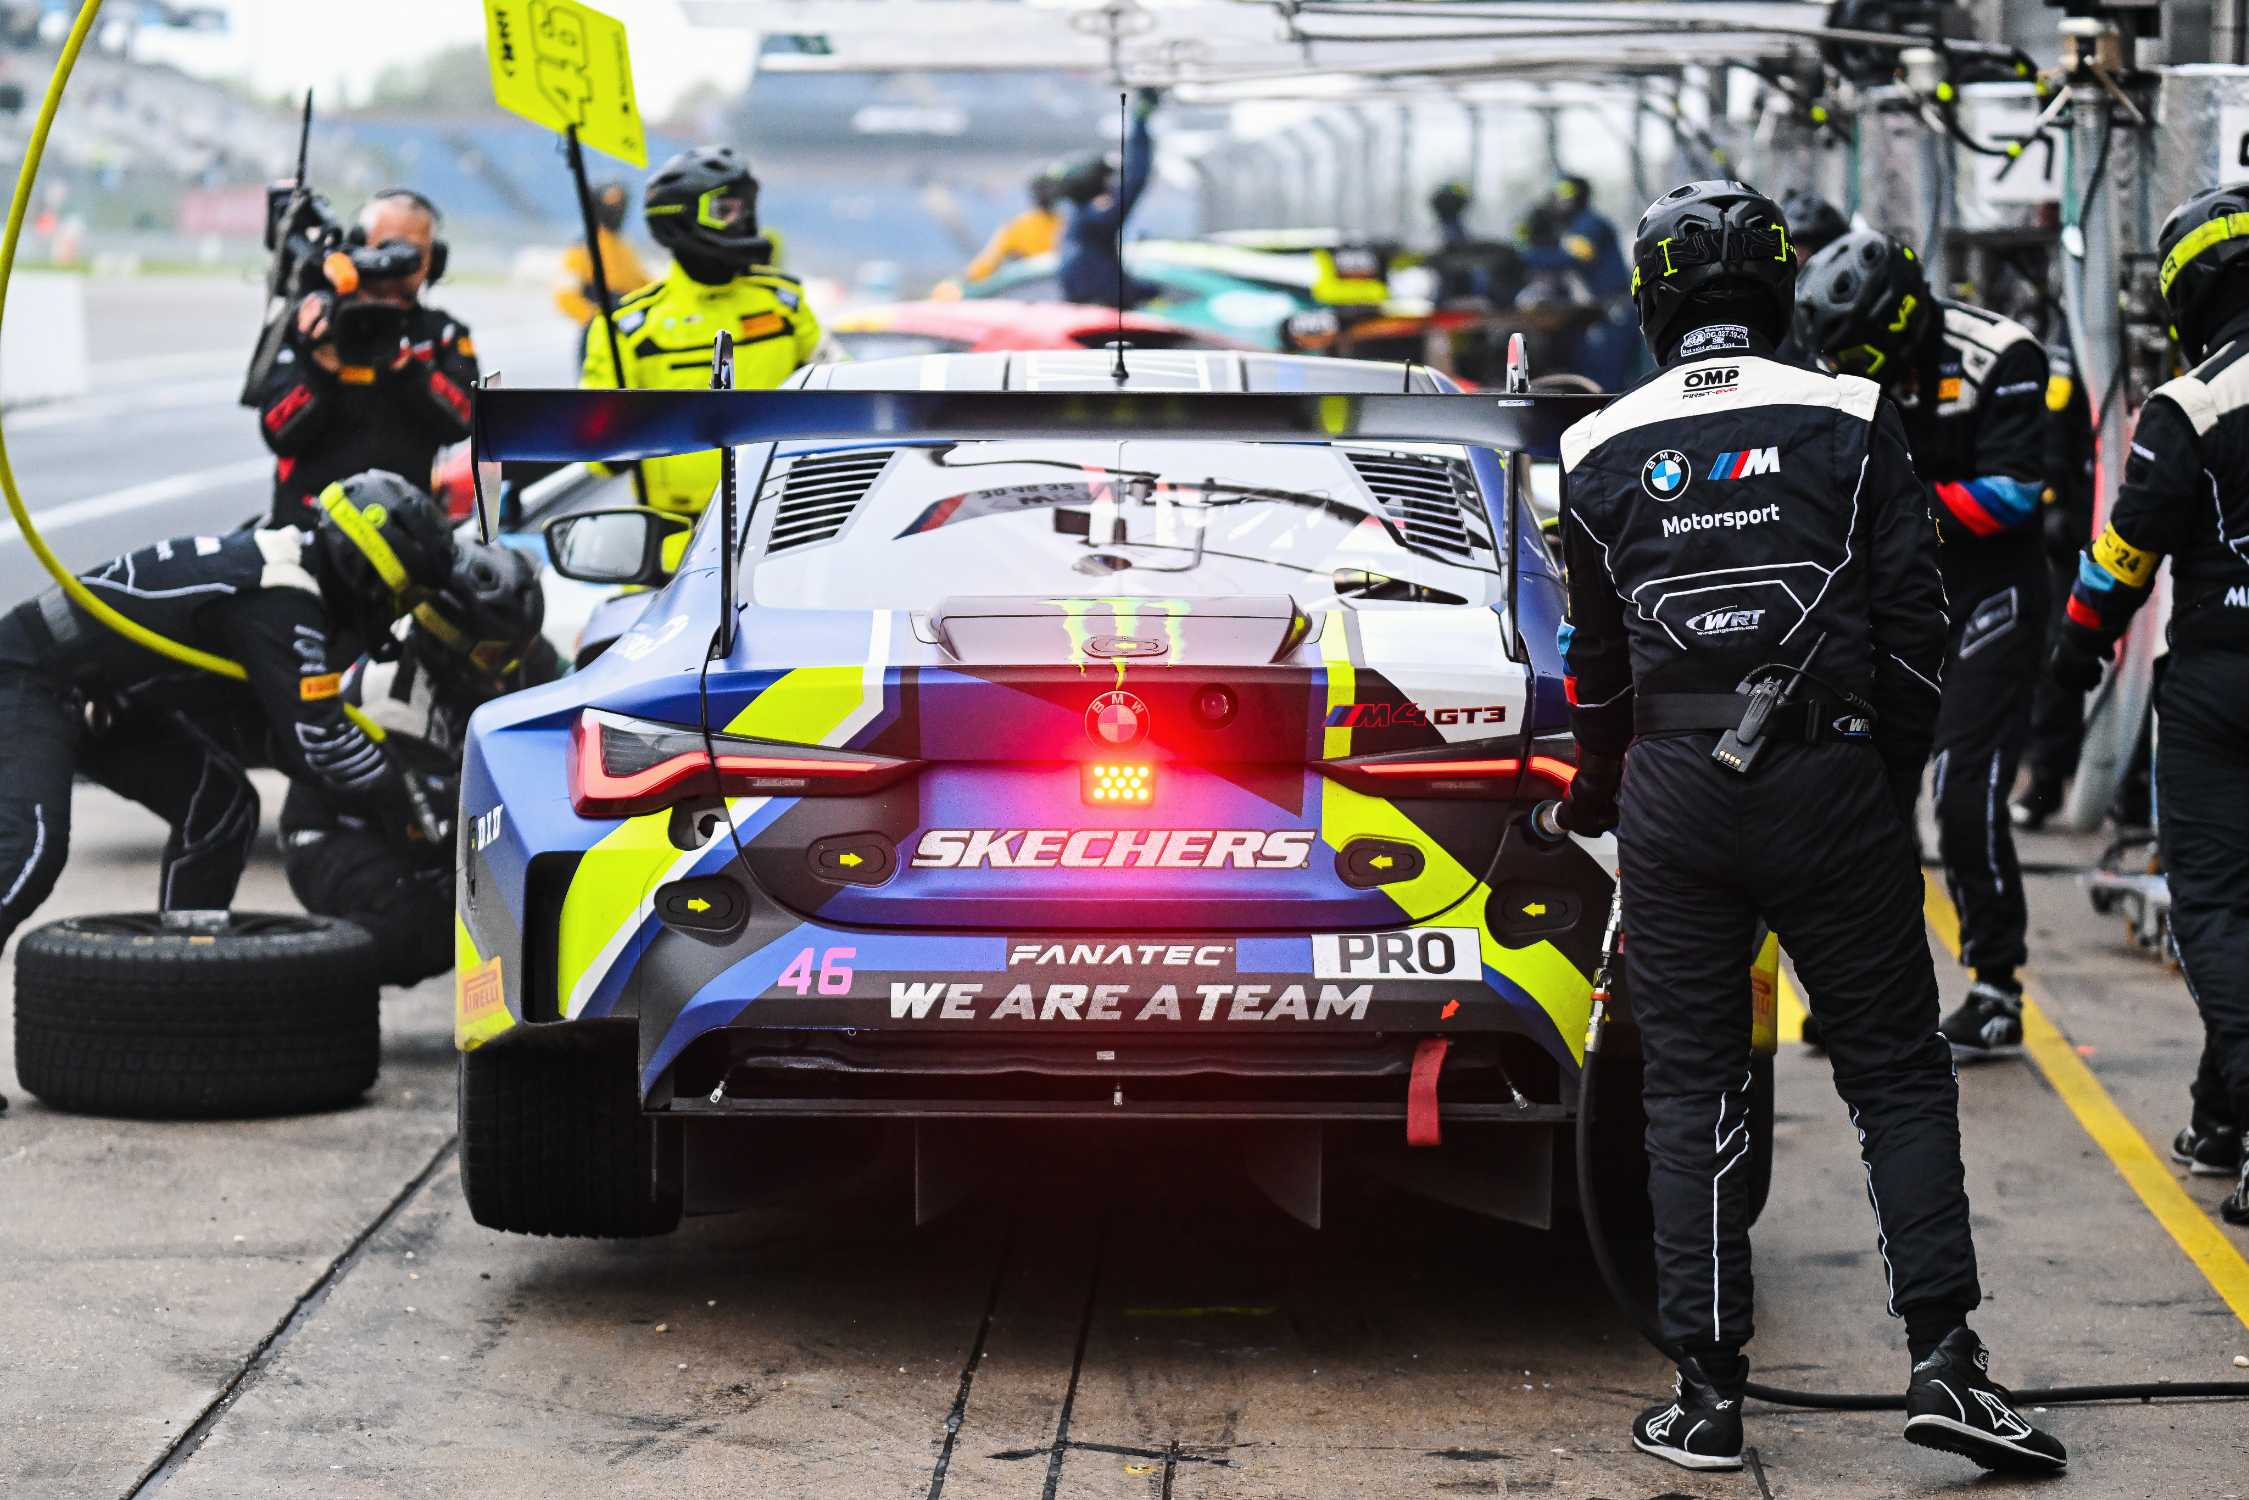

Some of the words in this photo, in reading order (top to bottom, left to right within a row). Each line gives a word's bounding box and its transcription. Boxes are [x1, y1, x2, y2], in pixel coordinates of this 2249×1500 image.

[1684, 369, 1740, 388] OMP
[1662, 503, 1780, 537] Motorsport
[1704, 608, 1766, 631] WRT
[1433, 706, 1506, 725] GT3
[910, 828, 1317, 870] SKECHERS
[1009, 943, 1229, 967] FANATEC
[1337, 931, 1456, 975] PRO
[777, 947, 857, 996] 46
[890, 982, 983, 1019] WE
[988, 983, 1130, 1020] ARE
[1134, 984, 1182, 1021] A
[1195, 984, 1374, 1021] TEAM
